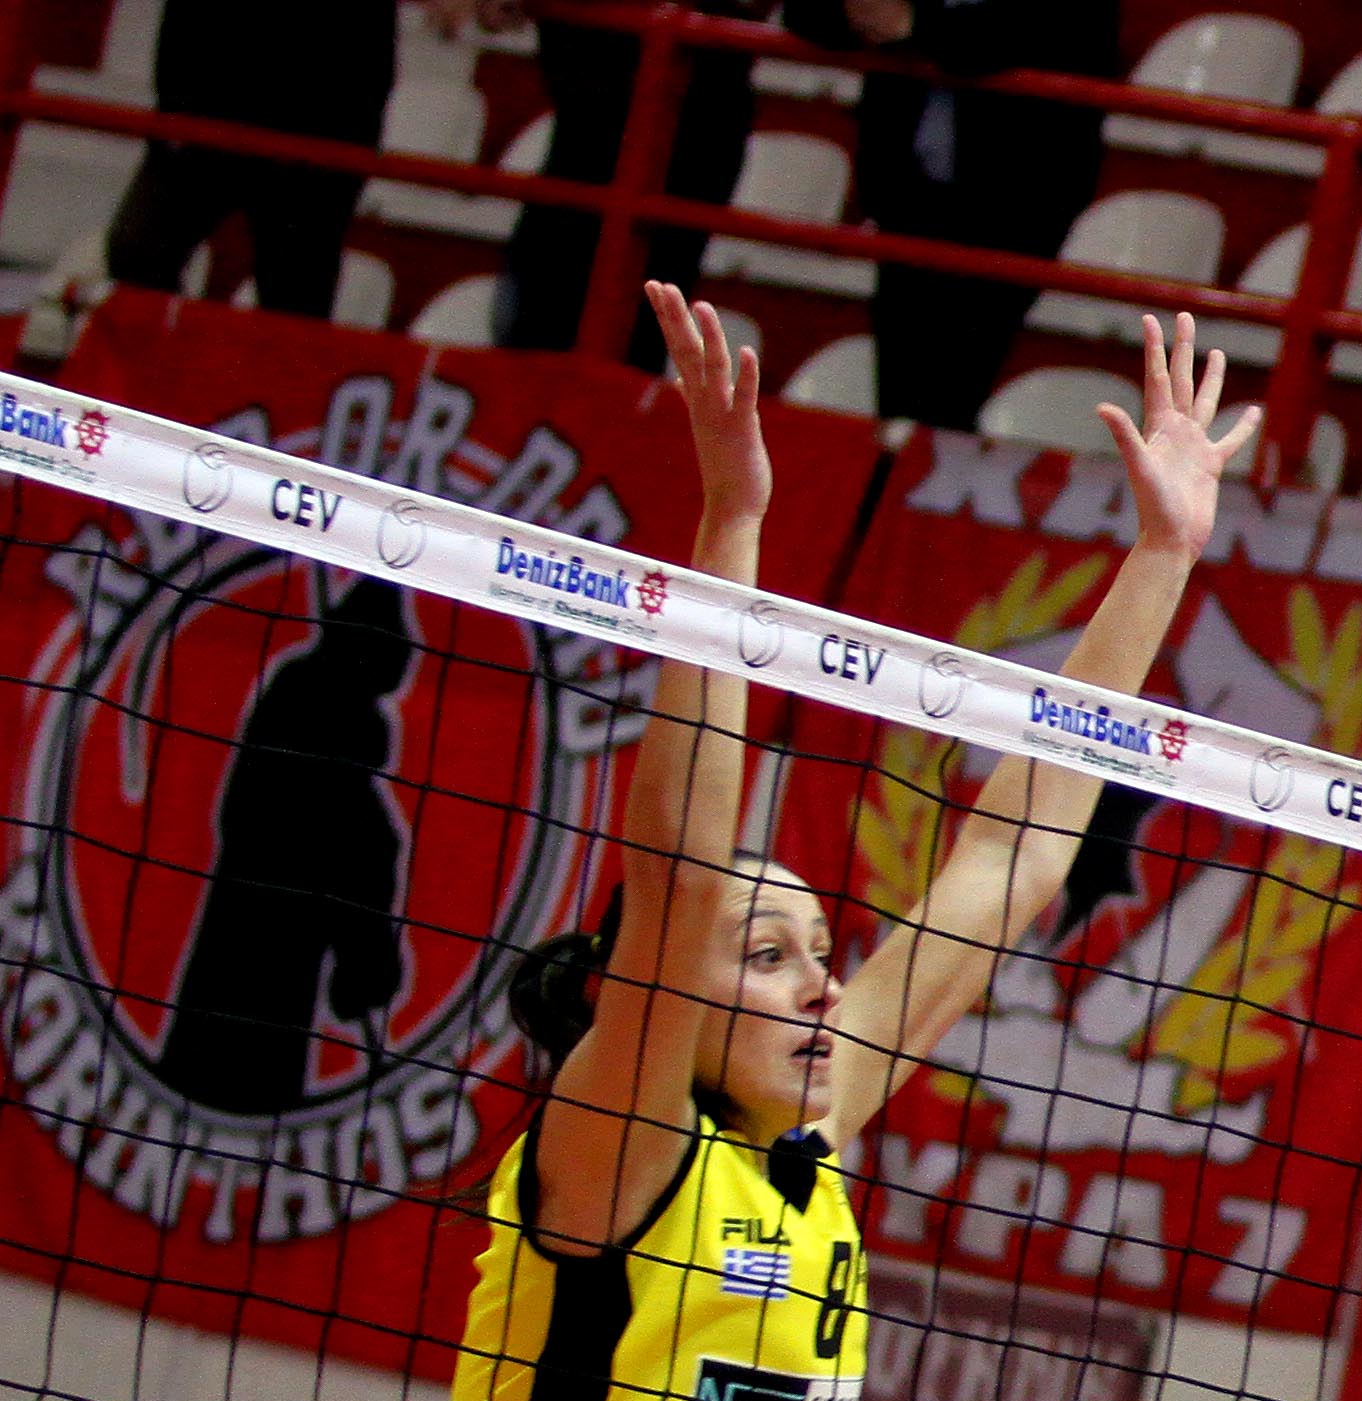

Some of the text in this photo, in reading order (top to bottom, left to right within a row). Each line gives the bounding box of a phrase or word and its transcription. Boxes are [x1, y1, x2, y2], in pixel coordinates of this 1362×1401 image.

[271, 478, 344, 533] CEV
[496, 536, 631, 609] DenizBank
[818, 633, 886, 685] CEV
[1031, 687, 1152, 756] DenizBank
[721, 1217, 792, 1247] FILA
[1206, 1197, 1308, 1310] 7
[815, 1241, 852, 1360] 8
